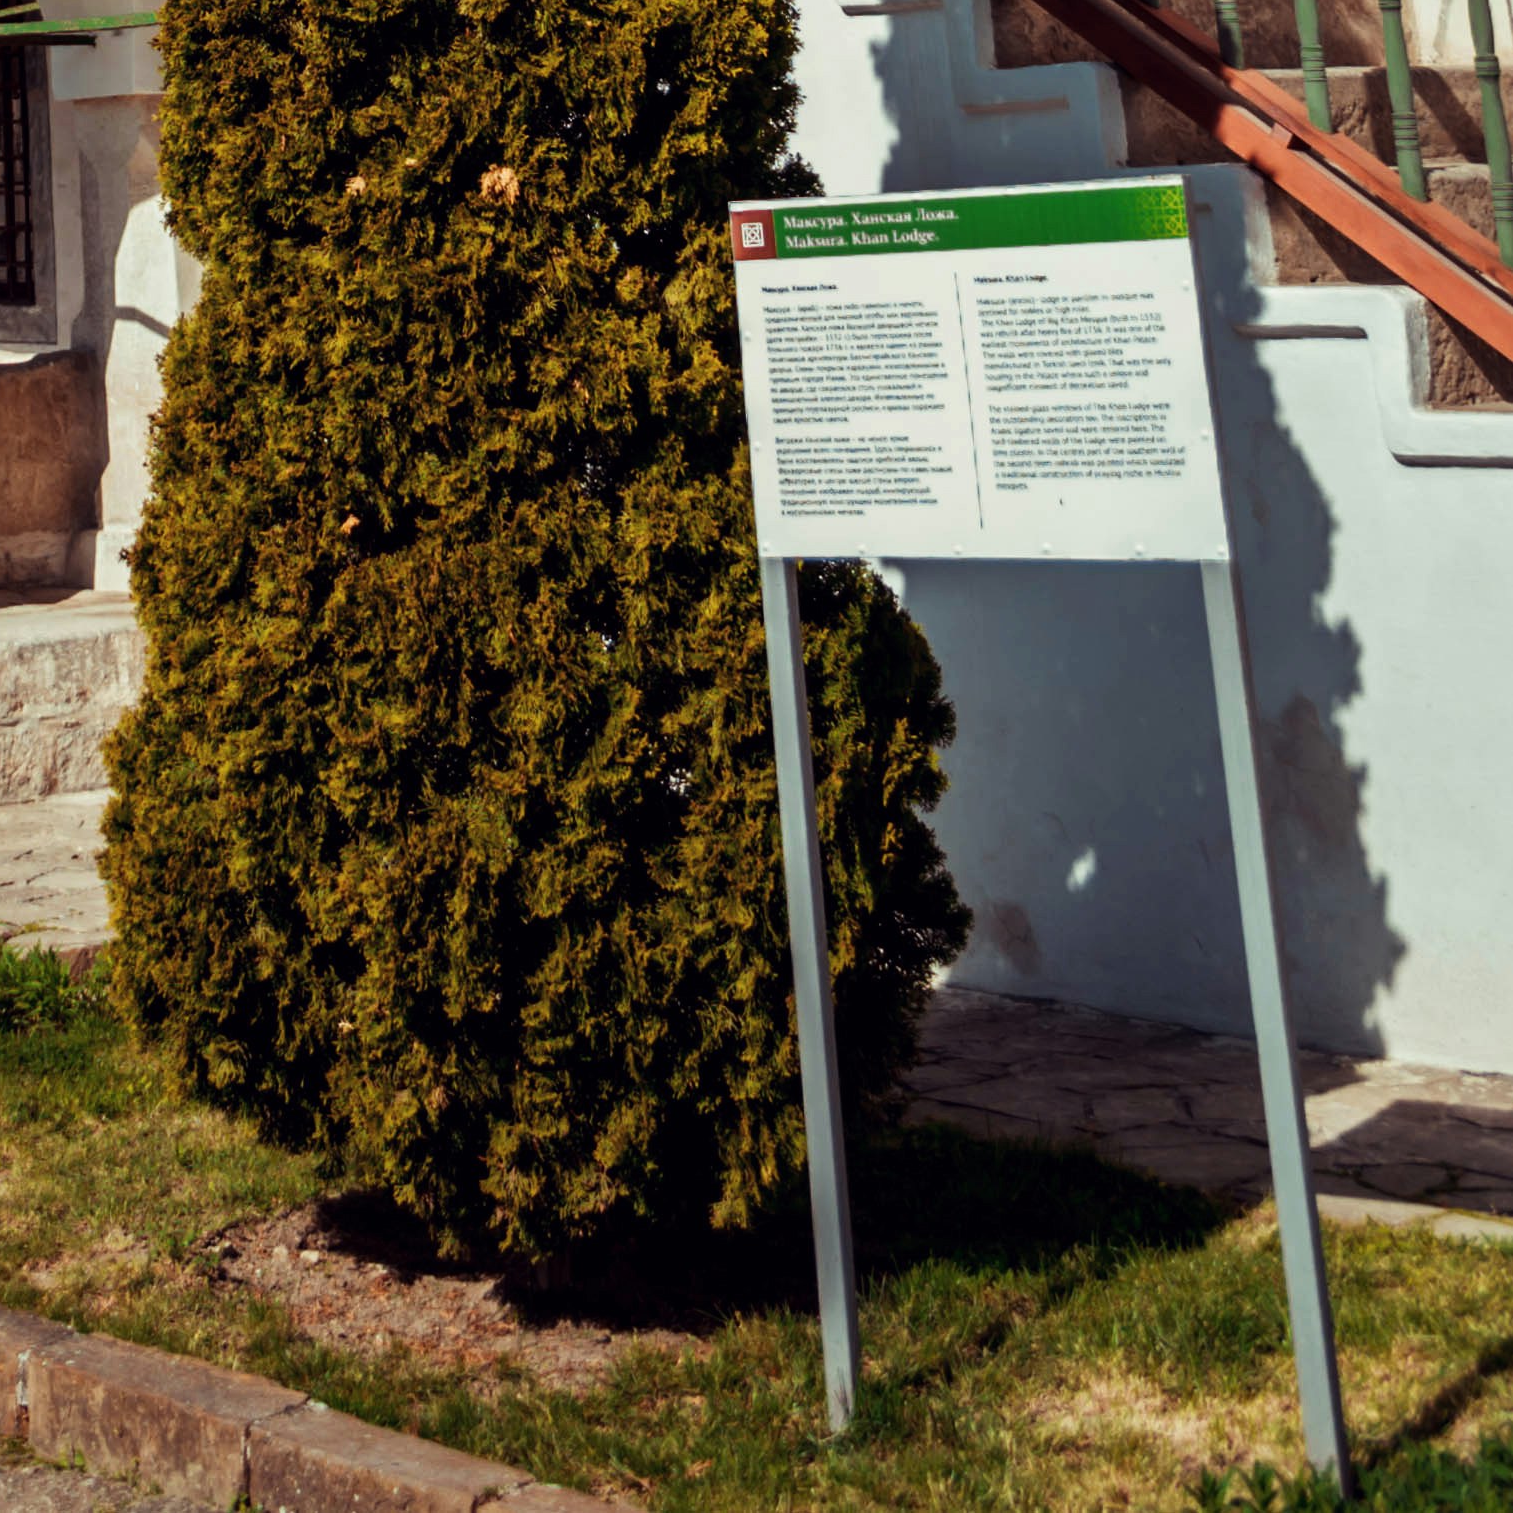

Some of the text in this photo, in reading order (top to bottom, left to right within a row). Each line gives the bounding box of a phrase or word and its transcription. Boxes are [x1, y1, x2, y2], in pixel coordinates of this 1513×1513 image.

[783, 208, 959, 230] Максура. Ханская Ложа.
[785, 228, 939, 248] Maksura. Khan Lodge.
